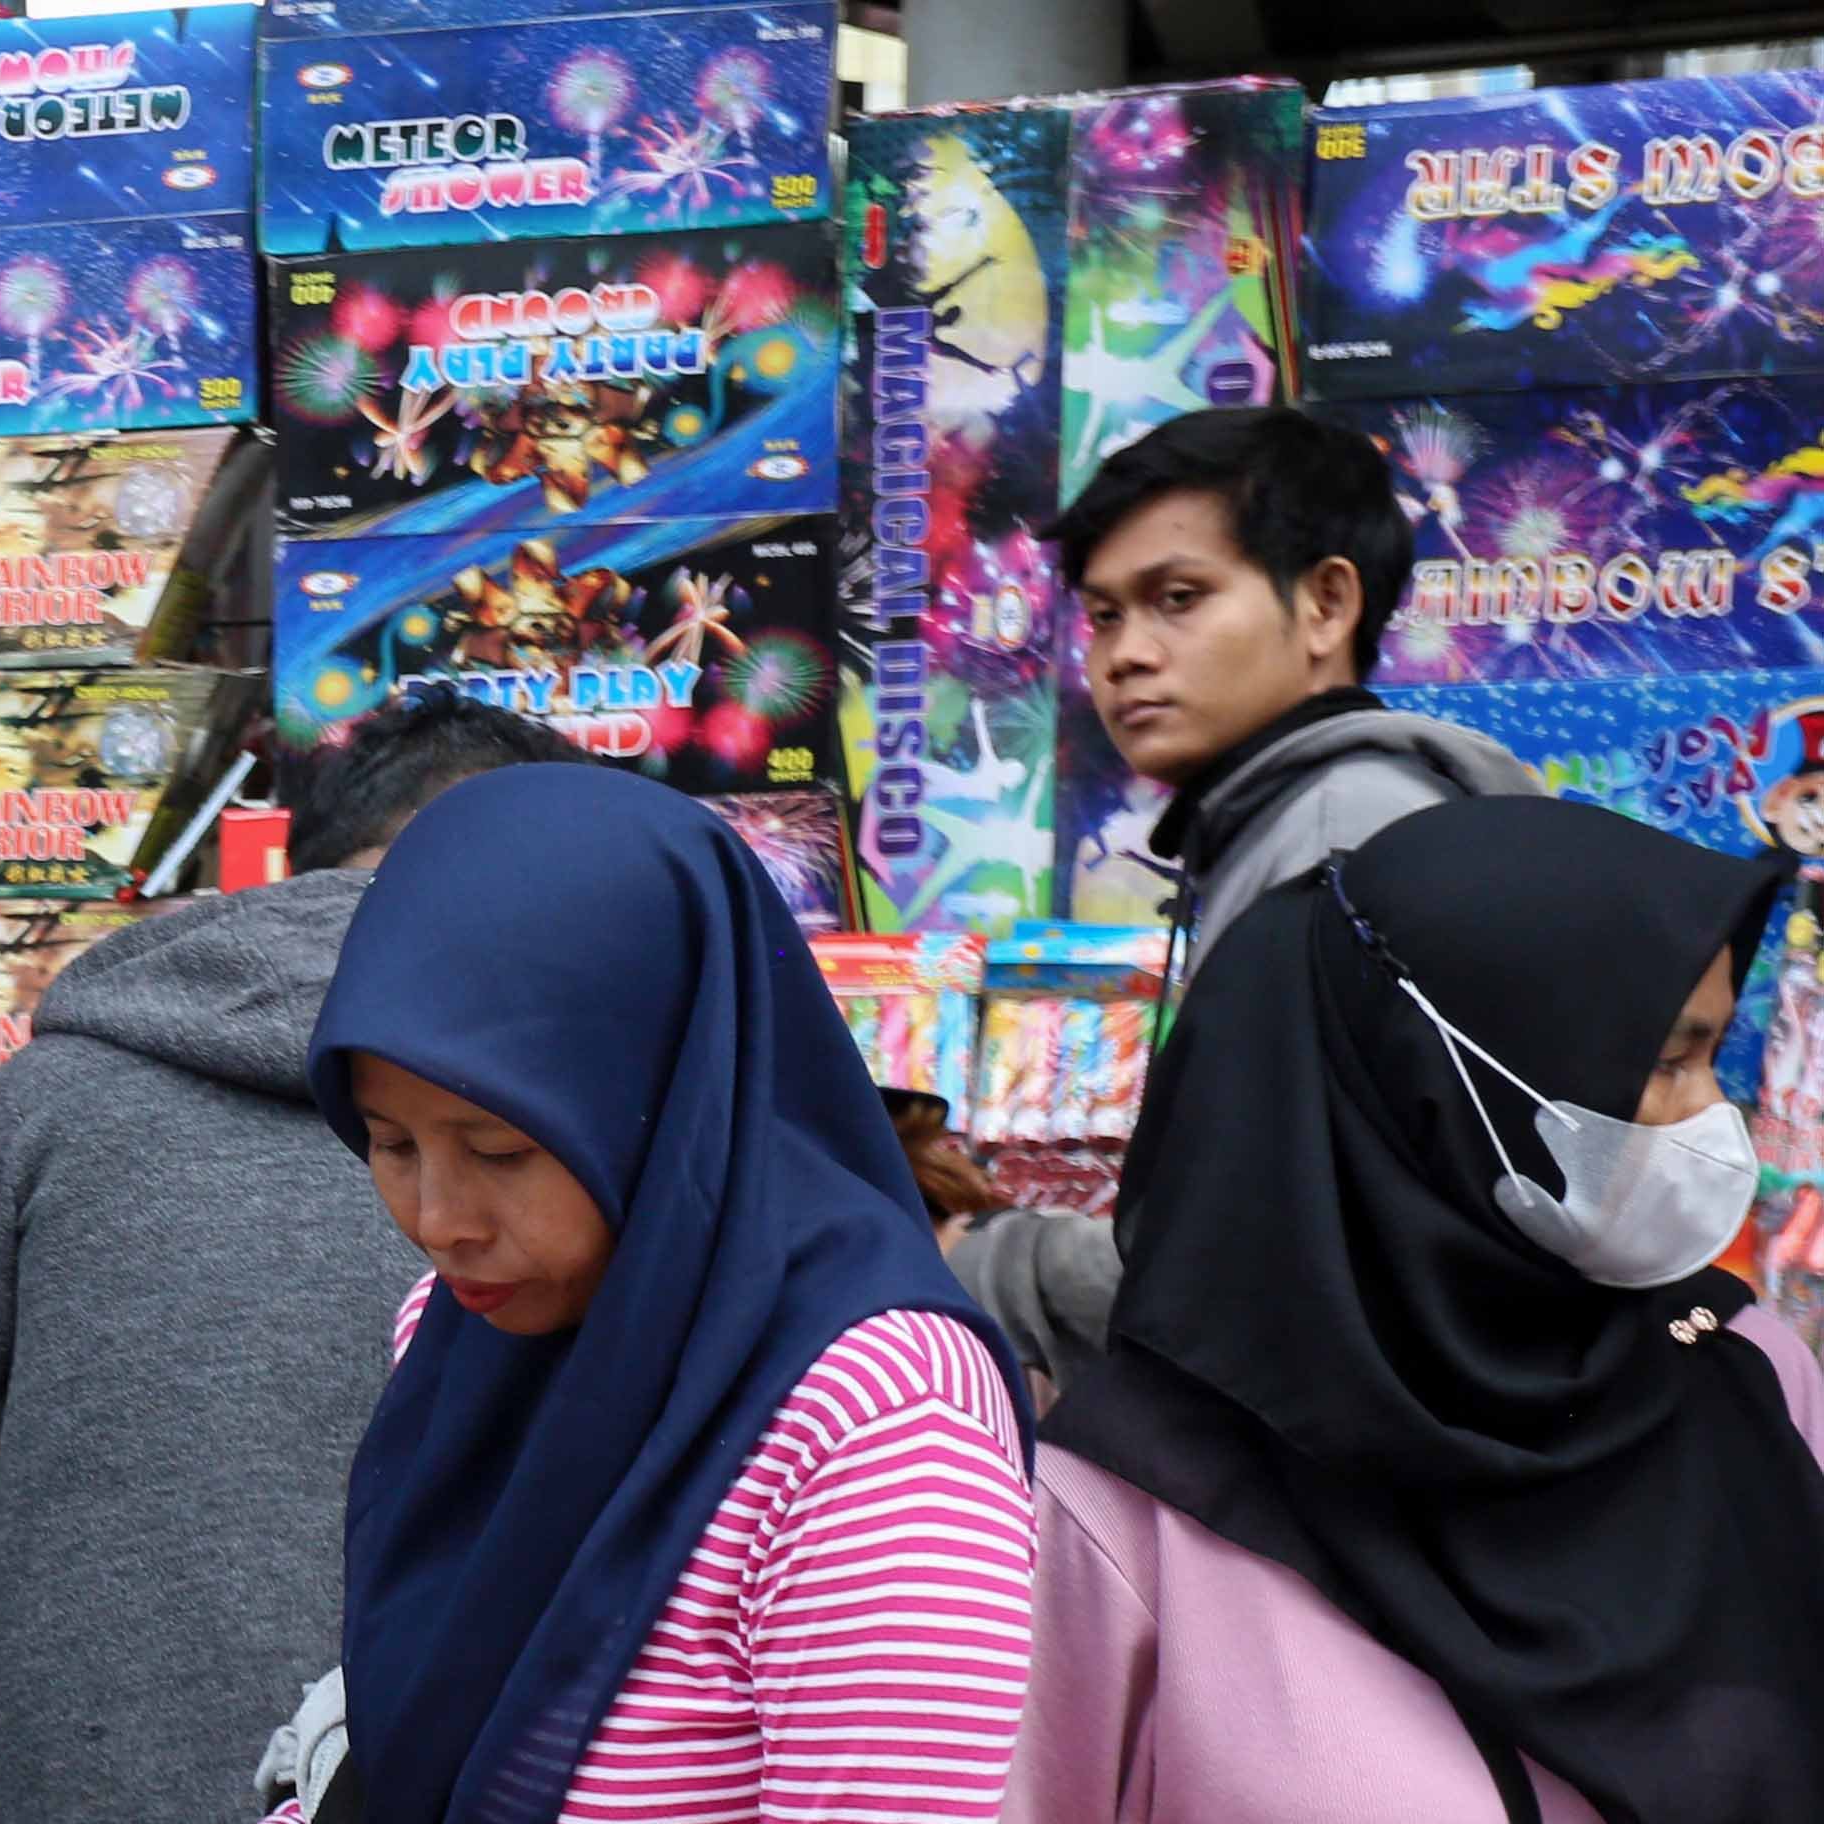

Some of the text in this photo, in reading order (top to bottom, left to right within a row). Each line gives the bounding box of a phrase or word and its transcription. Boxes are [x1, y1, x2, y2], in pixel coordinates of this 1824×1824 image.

[323, 113, 528, 170] METEOR
[379, 157, 595, 214] SHOWER
[400, 328, 706, 394] PARTY PLAY
[872, 305, 932, 859] MAGICAL DISCO
[1389, 548, 1736, 628] AINBOW
[568, 659, 703, 712] PLAY
